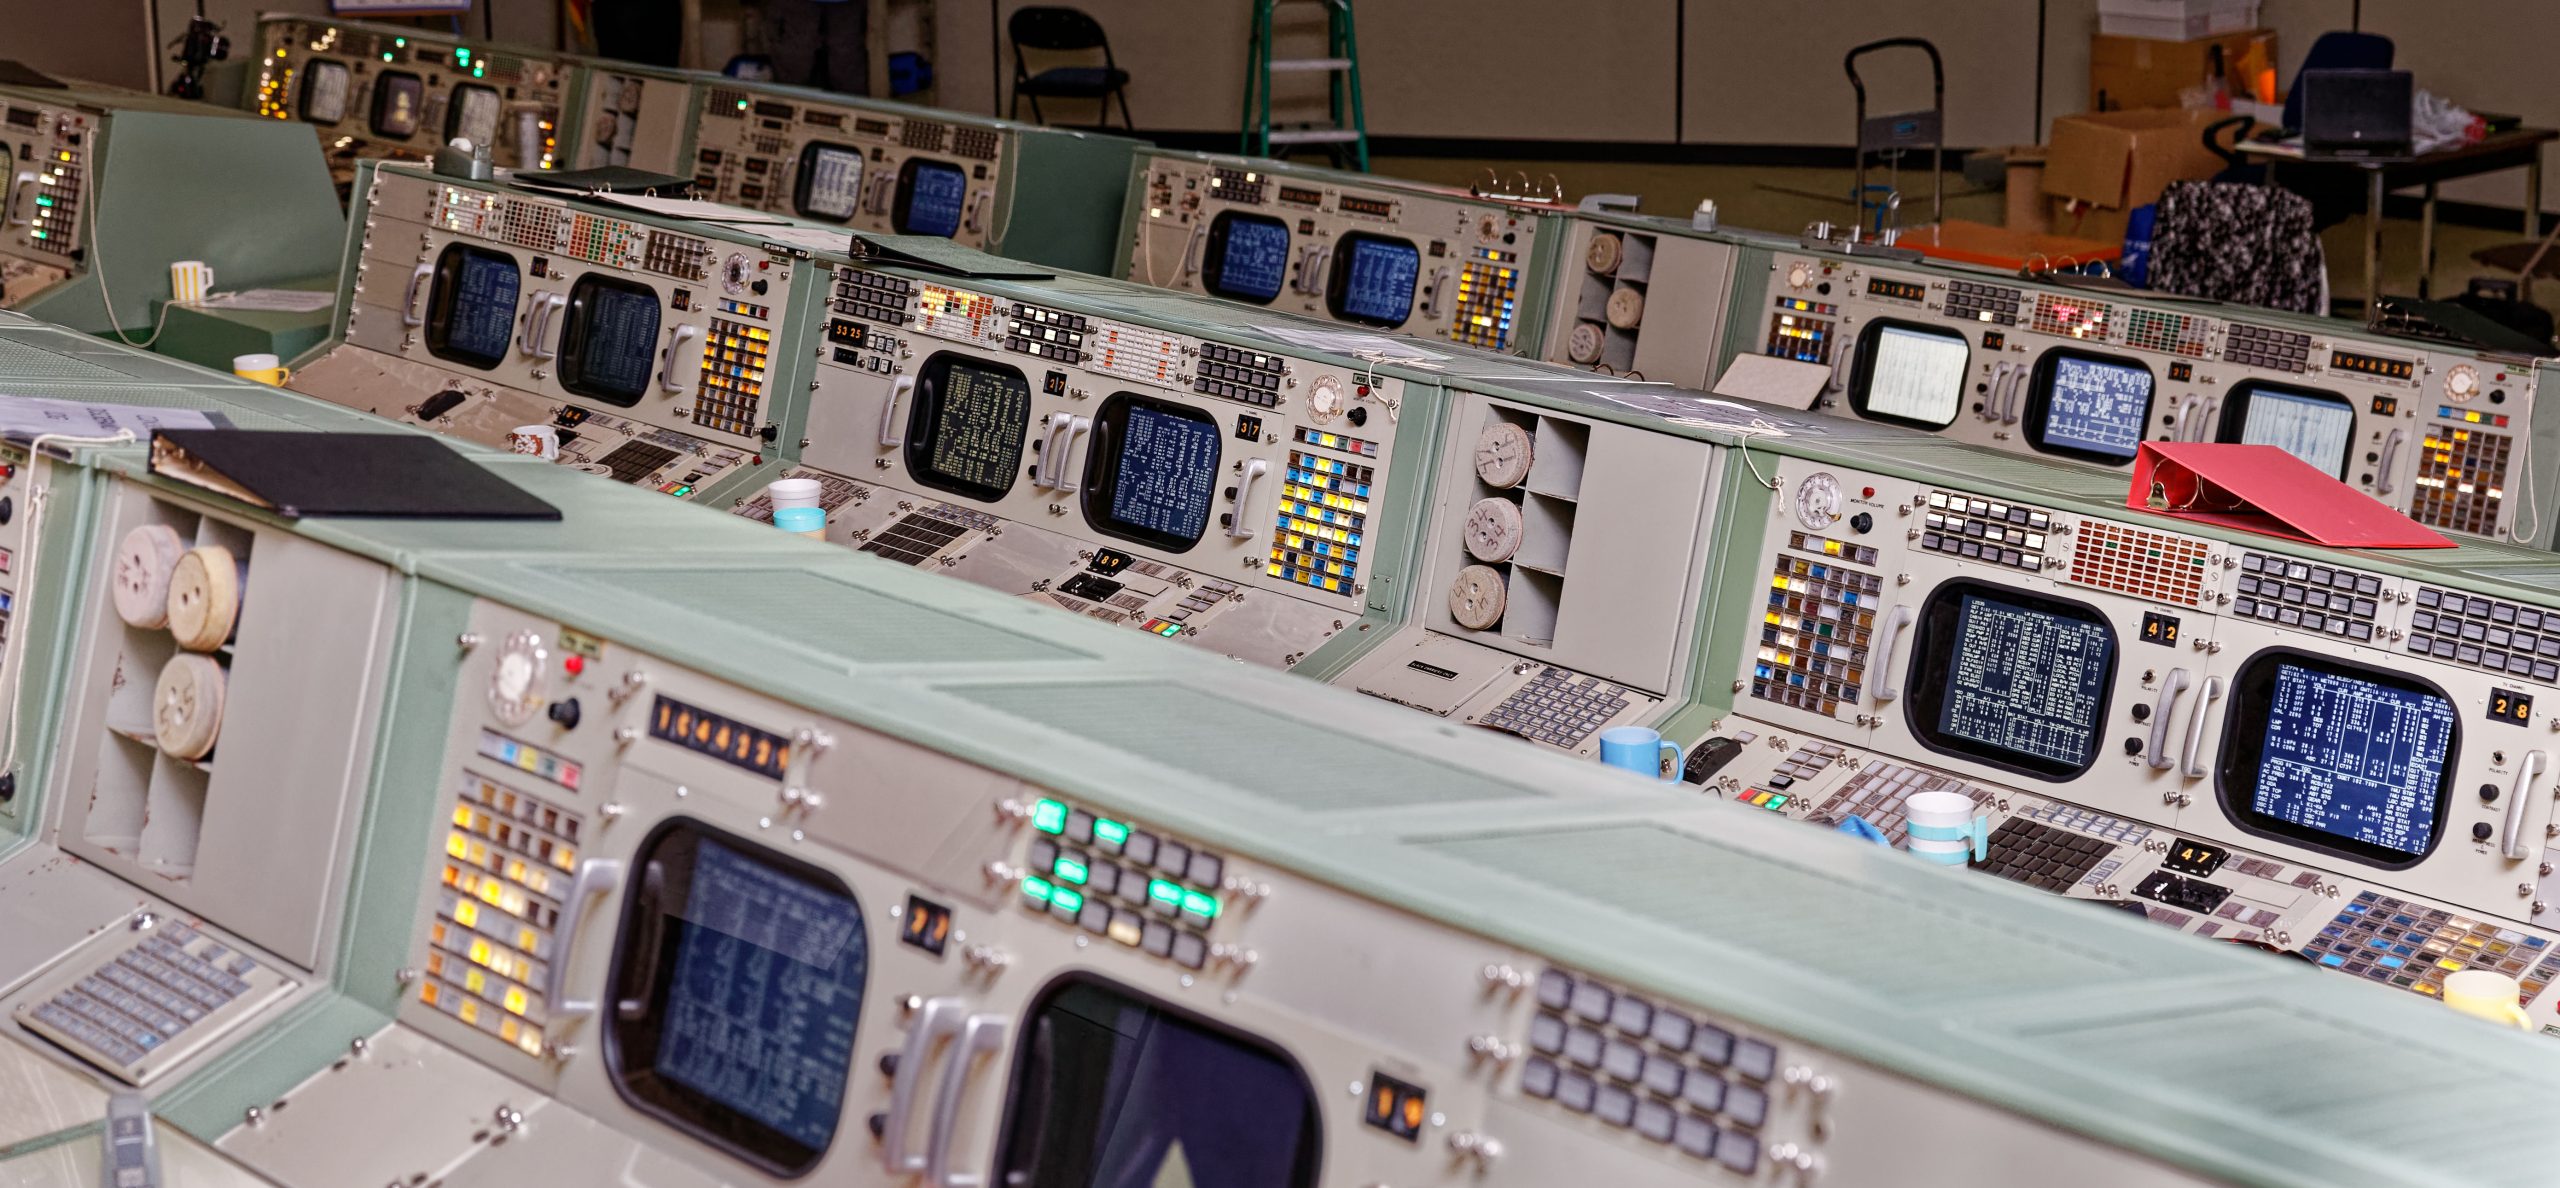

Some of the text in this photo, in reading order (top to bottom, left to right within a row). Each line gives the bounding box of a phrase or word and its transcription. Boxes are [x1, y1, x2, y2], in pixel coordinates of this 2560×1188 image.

[836, 325, 861, 338] 53 25
[1050, 378, 1066, 391] 27
[1241, 422, 1259, 436] 37
[1101, 555, 1119, 567] 89
[2148, 622, 2176, 640] 42
[2509, 683, 2525, 691] CHANNEL
[2496, 699, 2528, 719] 28
[2489, 767, 2508, 775] POLARITY
[2481, 804, 2501, 812] CONTRAST
[2181, 848, 2211, 863] 47
